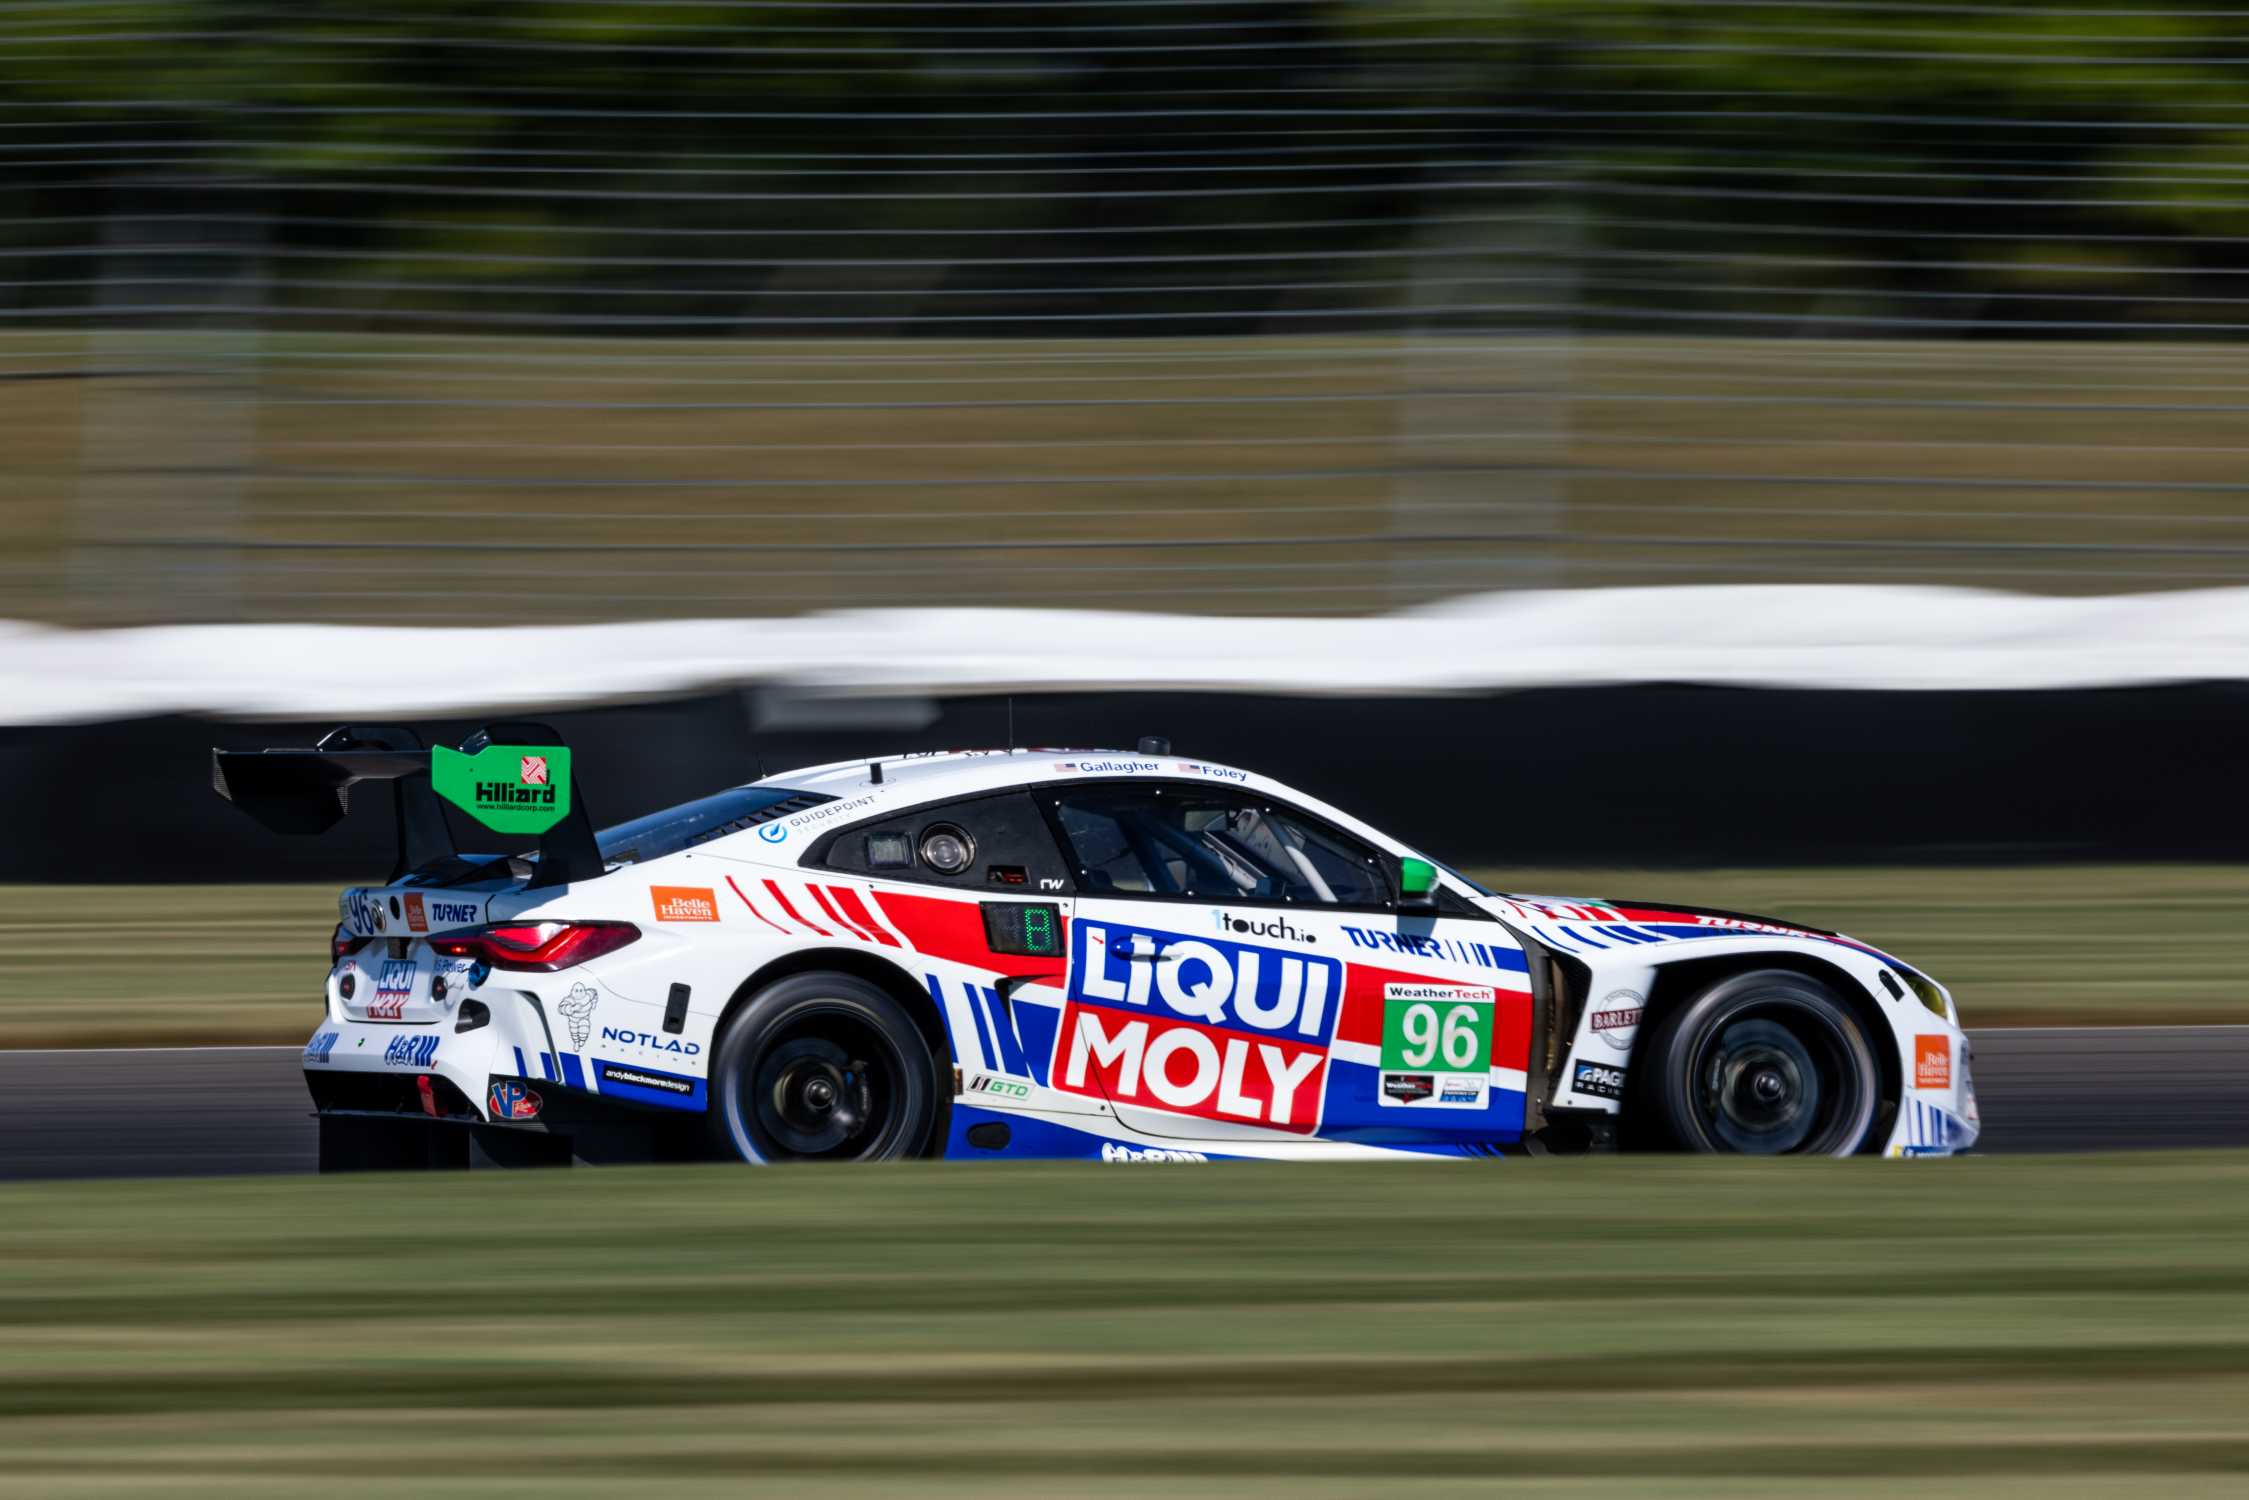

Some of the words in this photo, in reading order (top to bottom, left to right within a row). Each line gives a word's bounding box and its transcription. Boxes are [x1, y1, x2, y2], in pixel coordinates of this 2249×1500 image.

[1080, 762, 1160, 774] Gallagher
[1202, 766, 1247, 782] Foley
[476, 782, 555, 803] Hilliard
[790, 795, 875, 827] GUIDEPOINT
[349, 889, 374, 935] 96
[432, 903, 478, 923] TURNER
[661, 904, 713, 916] Haven
[671, 897, 710, 907] Belle
[1340, 925, 1446, 960] TURNER
[380, 962, 416, 989] LIQUI
[1081, 926, 1330, 1037] LIQUI
[367, 993, 409, 1017] MOLY
[1390, 987, 1490, 999] WeatherTech
[602, 1026, 700, 1055] NOTLAD
[1402, 1003, 1479, 1069] 96
[384, 1034, 420, 1066] H&R
[1065, 1011, 1324, 1125] MOLY
[491, 1080, 528, 1118] VP
[990, 1081, 1028, 1096] GTD
